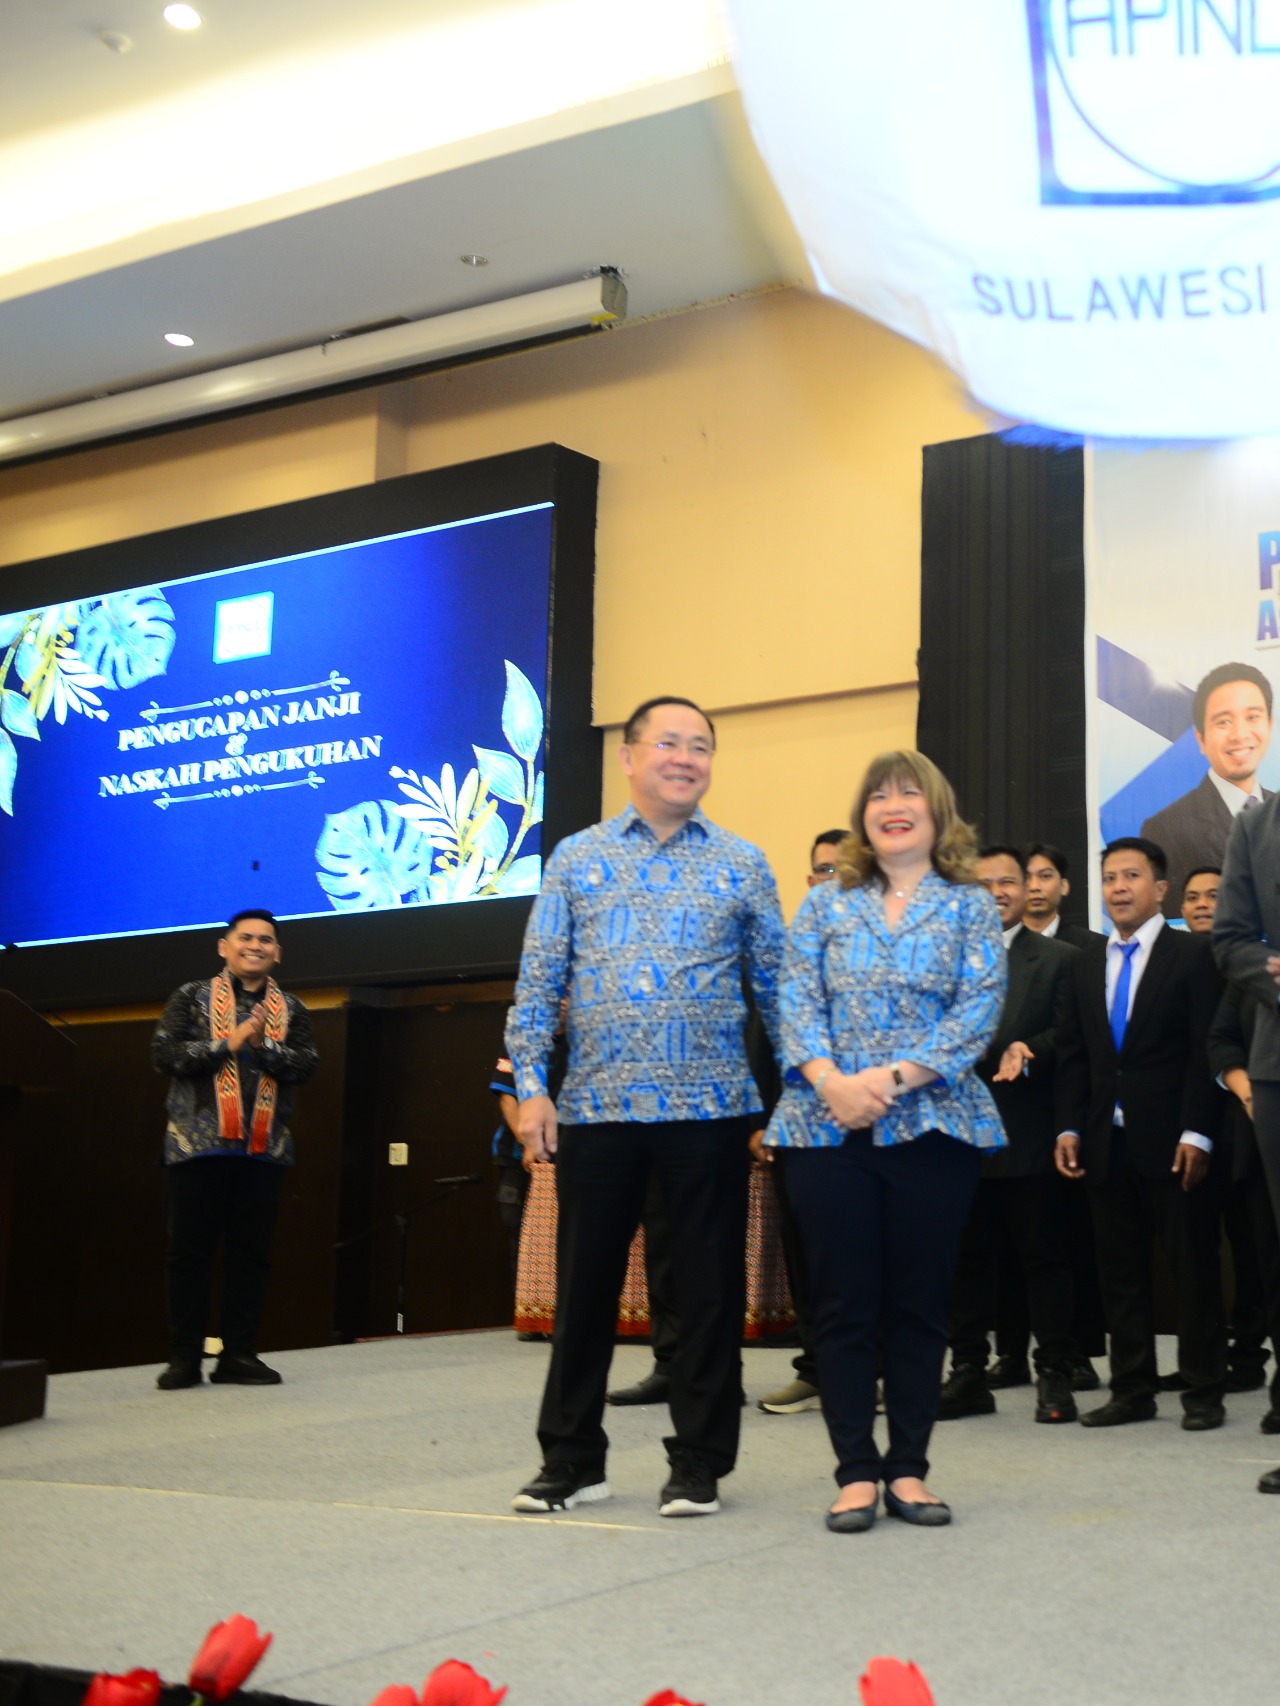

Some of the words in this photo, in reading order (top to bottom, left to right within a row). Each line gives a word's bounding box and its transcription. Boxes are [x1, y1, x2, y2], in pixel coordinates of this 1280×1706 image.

[971, 264, 1267, 321] SULAWESI
[117, 704, 281, 751] PENGUCAPAN
[282, 691, 361, 723] JANJI
[99, 762, 201, 797] NASKAH
[202, 735, 383, 782] PENGUKUHAN
